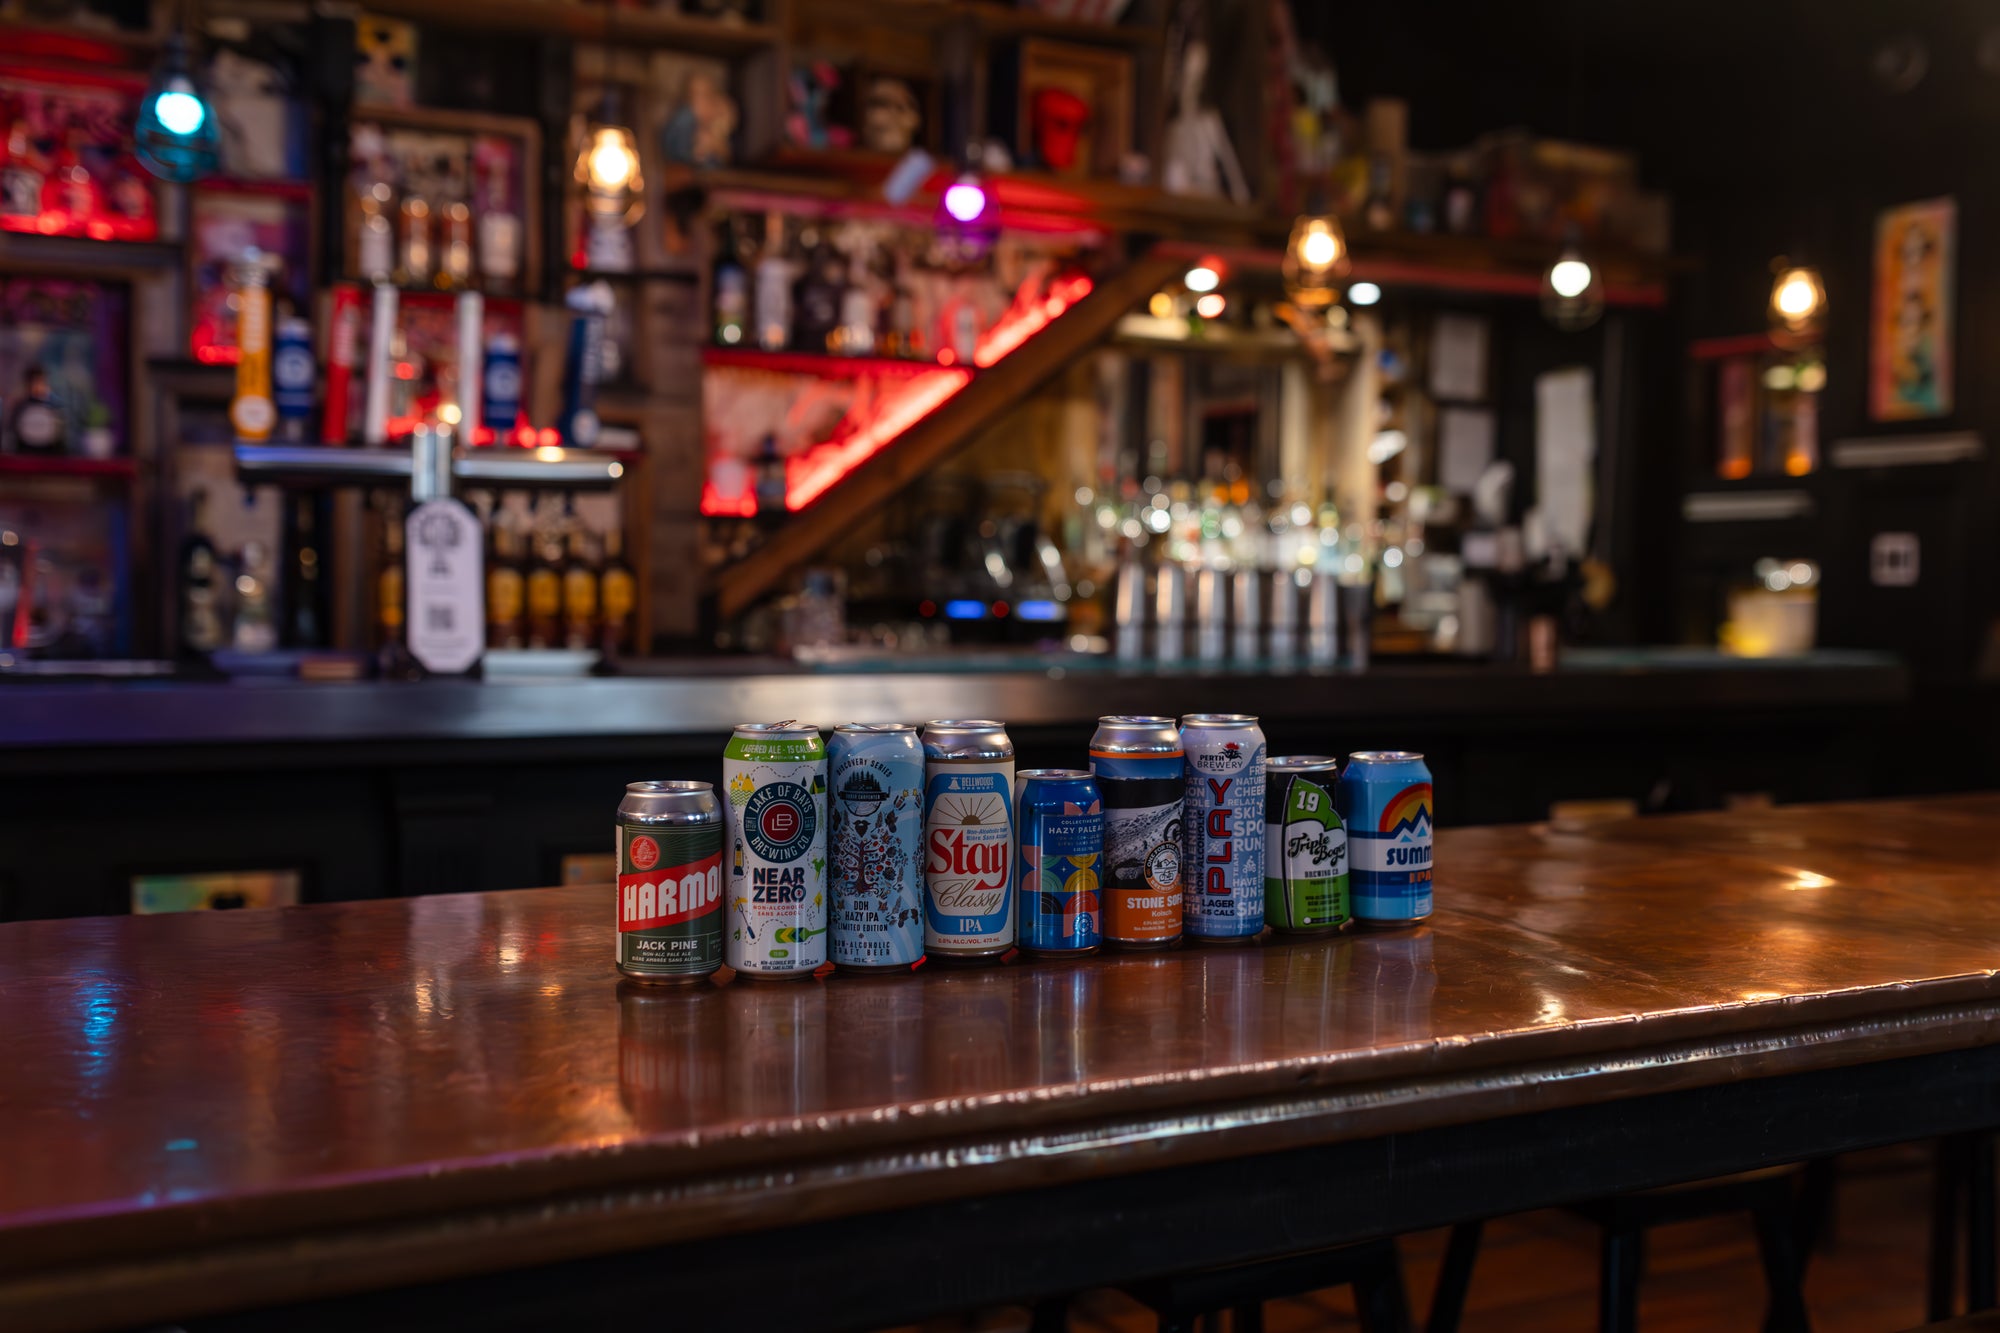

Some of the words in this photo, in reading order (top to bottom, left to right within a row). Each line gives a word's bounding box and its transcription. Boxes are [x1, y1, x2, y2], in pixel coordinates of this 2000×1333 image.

[741, 744, 767, 754] LAGERED
[768, 745, 781, 754] ALE
[836, 757, 867, 776] DISCOVERY
[870, 759, 893, 778] SERIES
[1197, 761, 1244, 769] BREWERY
[961, 776, 994, 787] BELLWOODS
[749, 787, 774, 813] LAKE
[777, 784, 791, 797] OF
[792, 788, 813, 813] BAYS
[1296, 790, 1320, 812] 19
[1234, 806, 1256, 820] SKI
[1078, 825, 1097, 833] PALE
[1206, 777, 1233, 896] PLAY
[751, 836, 798, 860] BREWING
[1188, 808, 1197, 895] REPLENISH
[1233, 836, 1262, 852] RUN
[1287, 832, 1329, 858] Triple
[927, 828, 1008, 890] Stay
[1197, 809, 1205, 895] NON-ALCOHOLIC
[753, 867, 805, 885] NEAR
[1304, 869, 1331, 878] BREWING
[1232, 877, 1257, 888] HAVE
[623, 861, 722, 922] HARMO
[752, 885, 807, 903] ZERO
[932, 879, 1001, 916] Classy
[1232, 887, 1257, 899] FUN
[1126, 896, 1165, 909] STONE
[1166, 892, 1183, 907] SOF
[1201, 899, 1234, 908] LAGER
[845, 911, 864, 921] HAZY
[866, 912, 879, 922] IPA
[1213, 909, 1235, 917] CALS
[837, 923, 861, 932] LIMITED
[862, 924, 888, 932] EDITION
[959, 918, 983, 933] IPA
[636, 940, 666, 950] JACK
[671, 940, 698, 950] PINE
[866, 949, 890, 957] BEER
